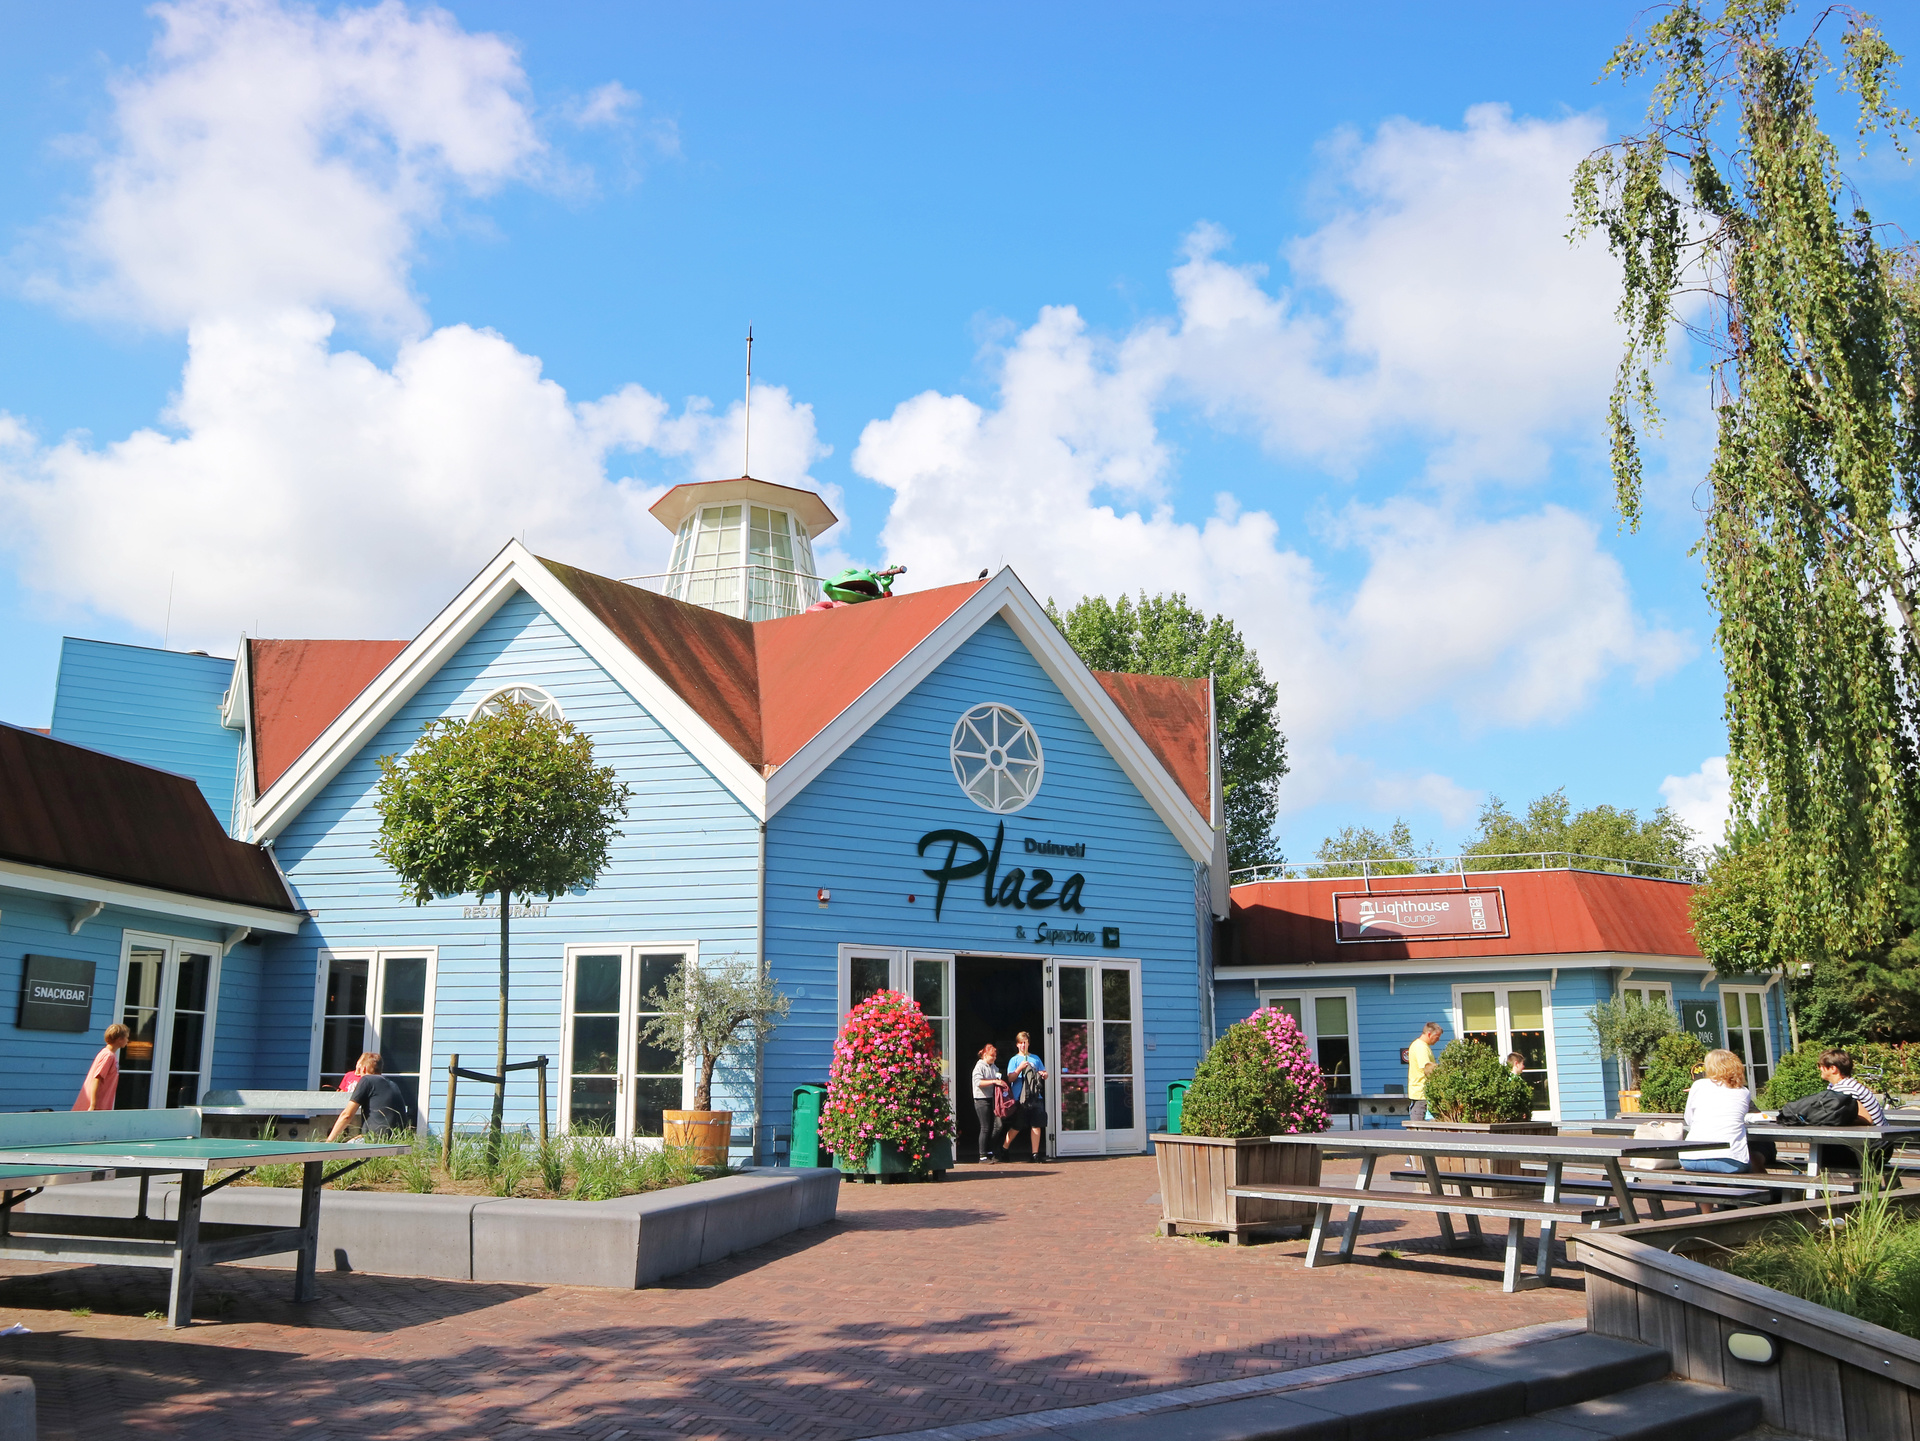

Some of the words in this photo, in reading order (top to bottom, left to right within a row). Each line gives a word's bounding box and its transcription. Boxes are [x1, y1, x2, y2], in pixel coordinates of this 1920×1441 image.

[1024, 837, 1086, 859] Duinrell
[917, 819, 1086, 922] Plaza
[1374, 899, 1450, 916] Lighthouse
[1396, 911, 1437, 925] Lounge
[1016, 925, 1026, 939] &
[1034, 921, 1096, 946] Superstore
[34, 986, 85, 1001] SNACKBAR
